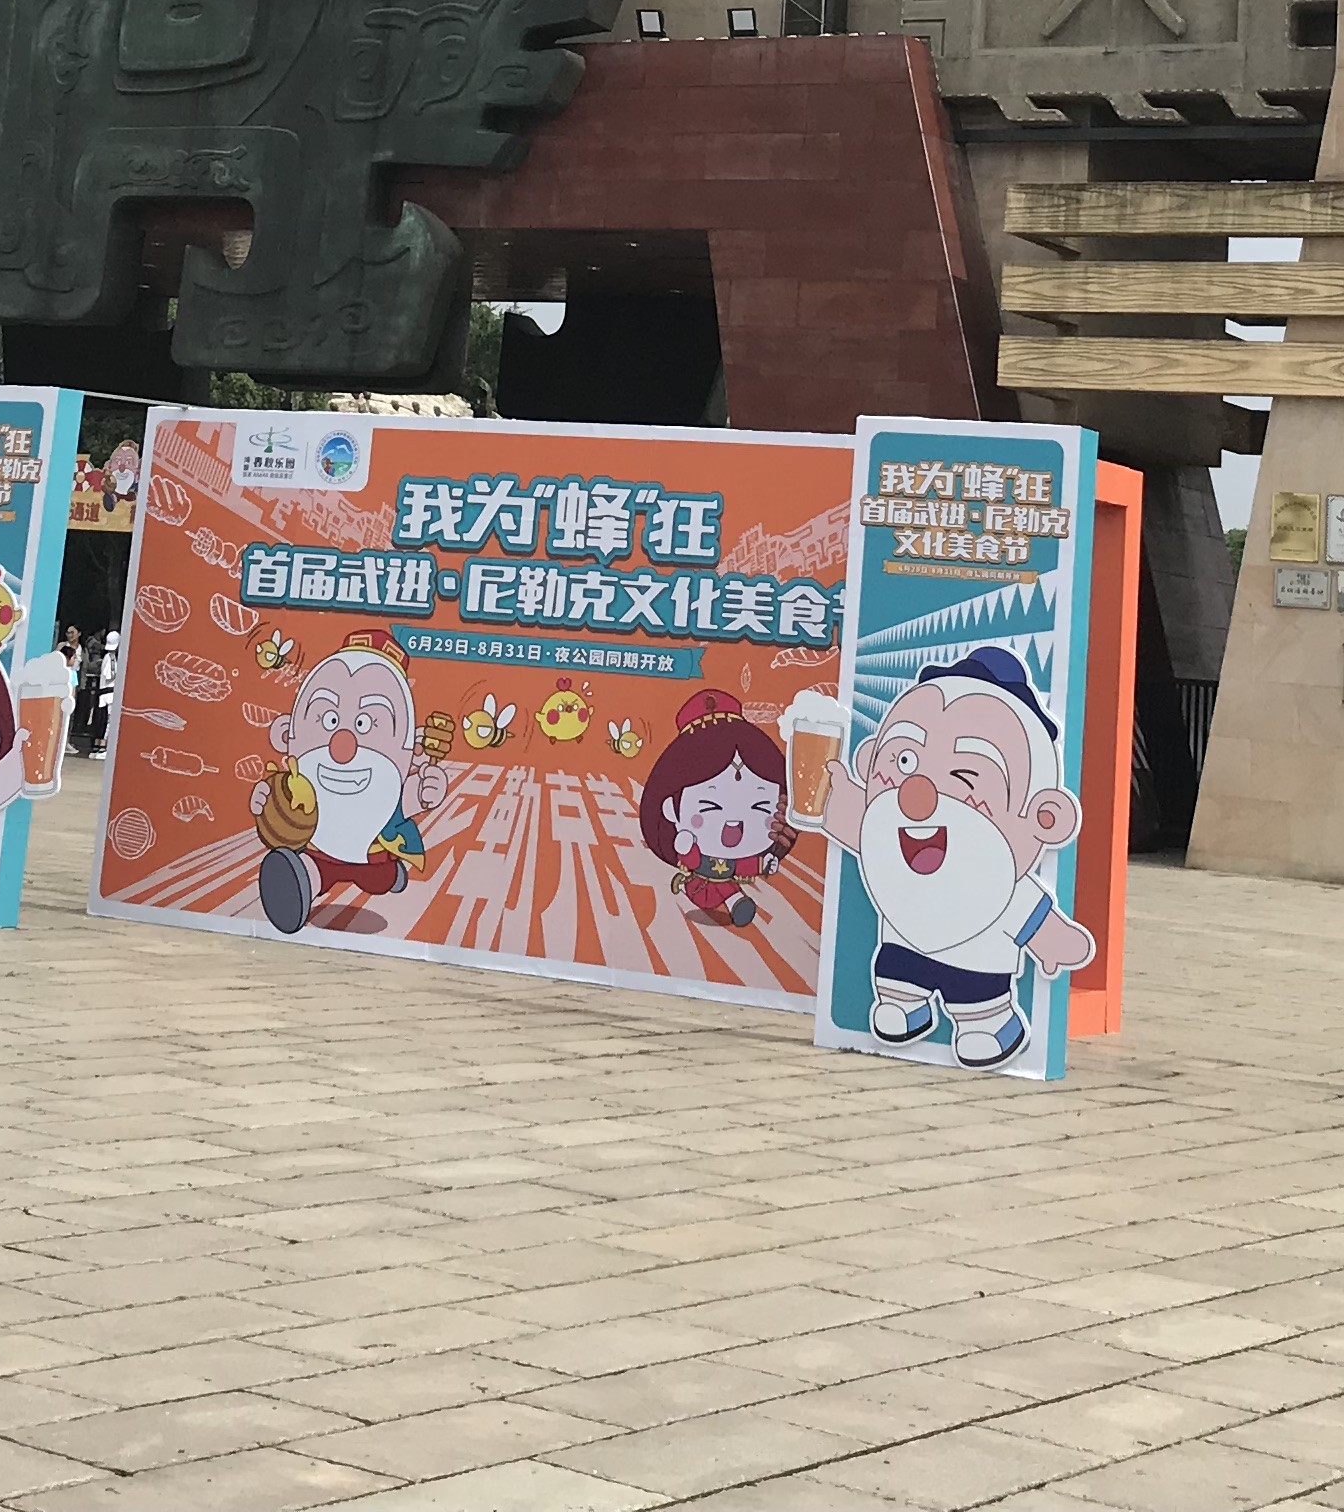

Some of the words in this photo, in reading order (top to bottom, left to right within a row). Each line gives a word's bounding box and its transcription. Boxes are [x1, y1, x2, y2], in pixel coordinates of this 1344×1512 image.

[861, 497, 1070, 536] 首届武进·尼勒克
[895, 529, 1031, 564] 文化美食节
